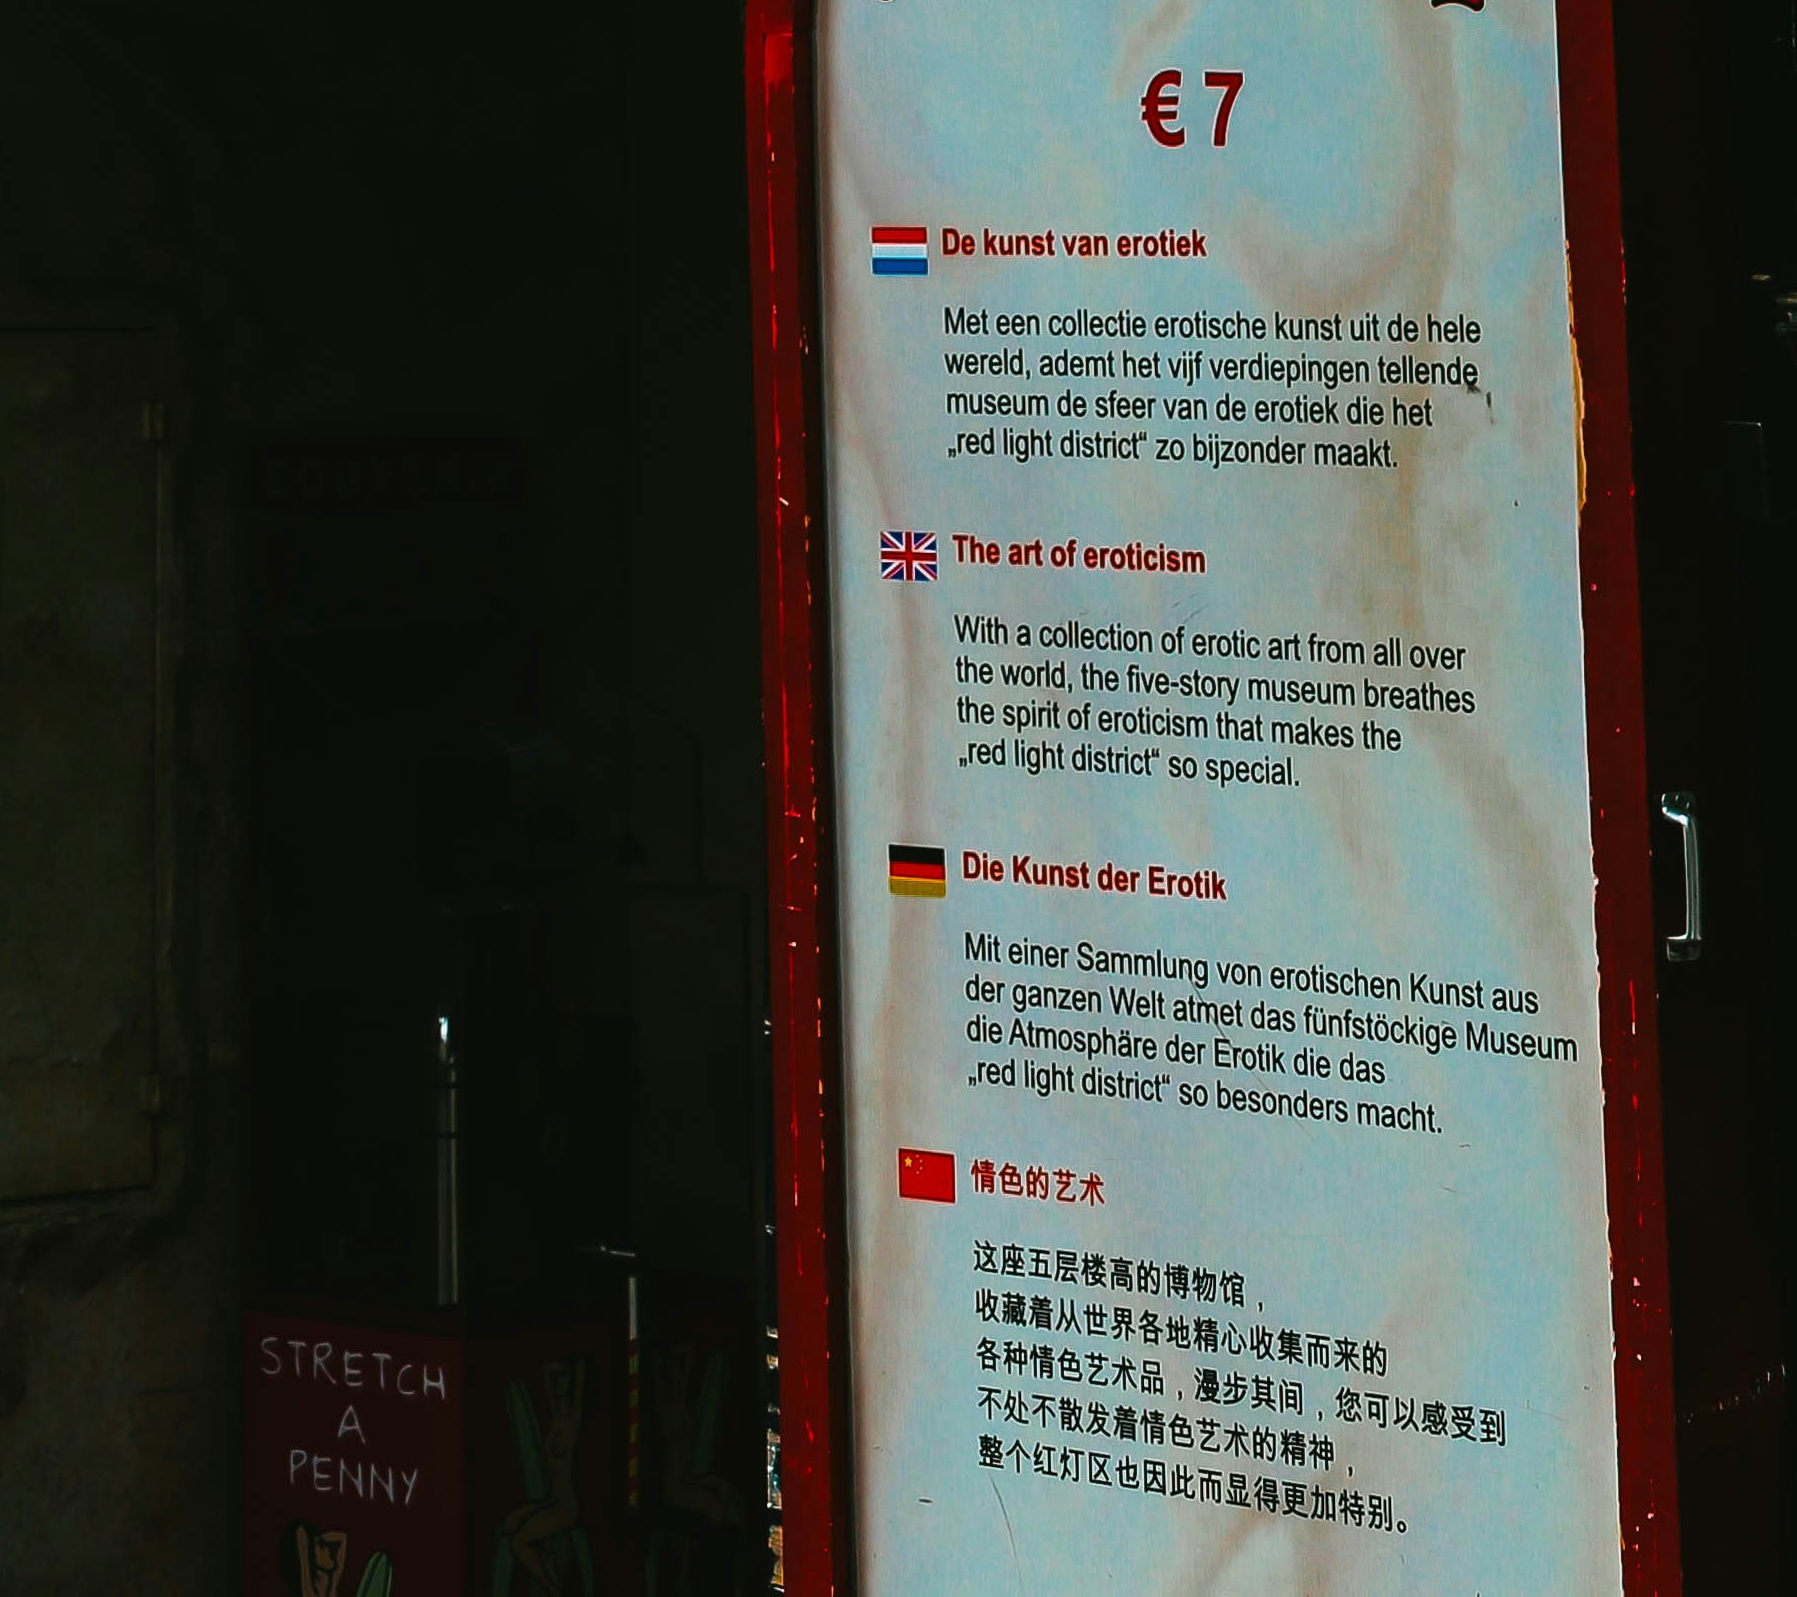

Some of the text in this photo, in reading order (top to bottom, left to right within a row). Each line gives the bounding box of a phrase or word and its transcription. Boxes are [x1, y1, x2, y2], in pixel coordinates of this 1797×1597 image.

[1140, 68, 1245, 147] € 7
[941, 226, 1208, 258] De kunst van erotiek
[943, 305, 1482, 345] Met een collectie erotische kunst uit de hele
[943, 346, 1480, 393] wereld, ademt het vijf verdiepingen tellende
[946, 387, 1434, 428] museum de sfeer van de erotiek die het
[1002, 426, 1054, 465] light
[1154, 437, 1186, 462] zo
[1192, 431, 1308, 471] bijzonder
[1313, 436, 1398, 469] maakt.
[951, 533, 1207, 575] The art of eroticism
[953, 613, 1467, 671] With a collection of erotic art from all over
[954, 654, 1477, 715] the world, the five-story museum breathes
[955, 694, 1402, 753] the spirit of eroticism that makes the
[1013, 737, 1066, 777] light
[1167, 754, 1199, 780] so
[1204, 753, 1301, 790] special.
[962, 850, 1228, 902] Die Kunst der Erotik
[964, 930, 1540, 1016] Mit einer Sammlung von erotischen Kunst aus
[964, 972, 1578, 1063] der ganzen Welt atmet das fünfstöckige Museum
[965, 1012, 1386, 1086] die Atmosphäre der Erotik die das
[1023, 1058, 1076, 1099] light
[1178, 1082, 1209, 1109] so
[1215, 1078, 1350, 1124] besonders
[1356, 1099, 1443, 1135] macht.
[969, 1157, 1106, 1208] 情色的艺术
[259, 1335, 448, 1401] STRETCH
[337, 1404, 367, 1445] A
[289, 1448, 420, 1507] PENNY
